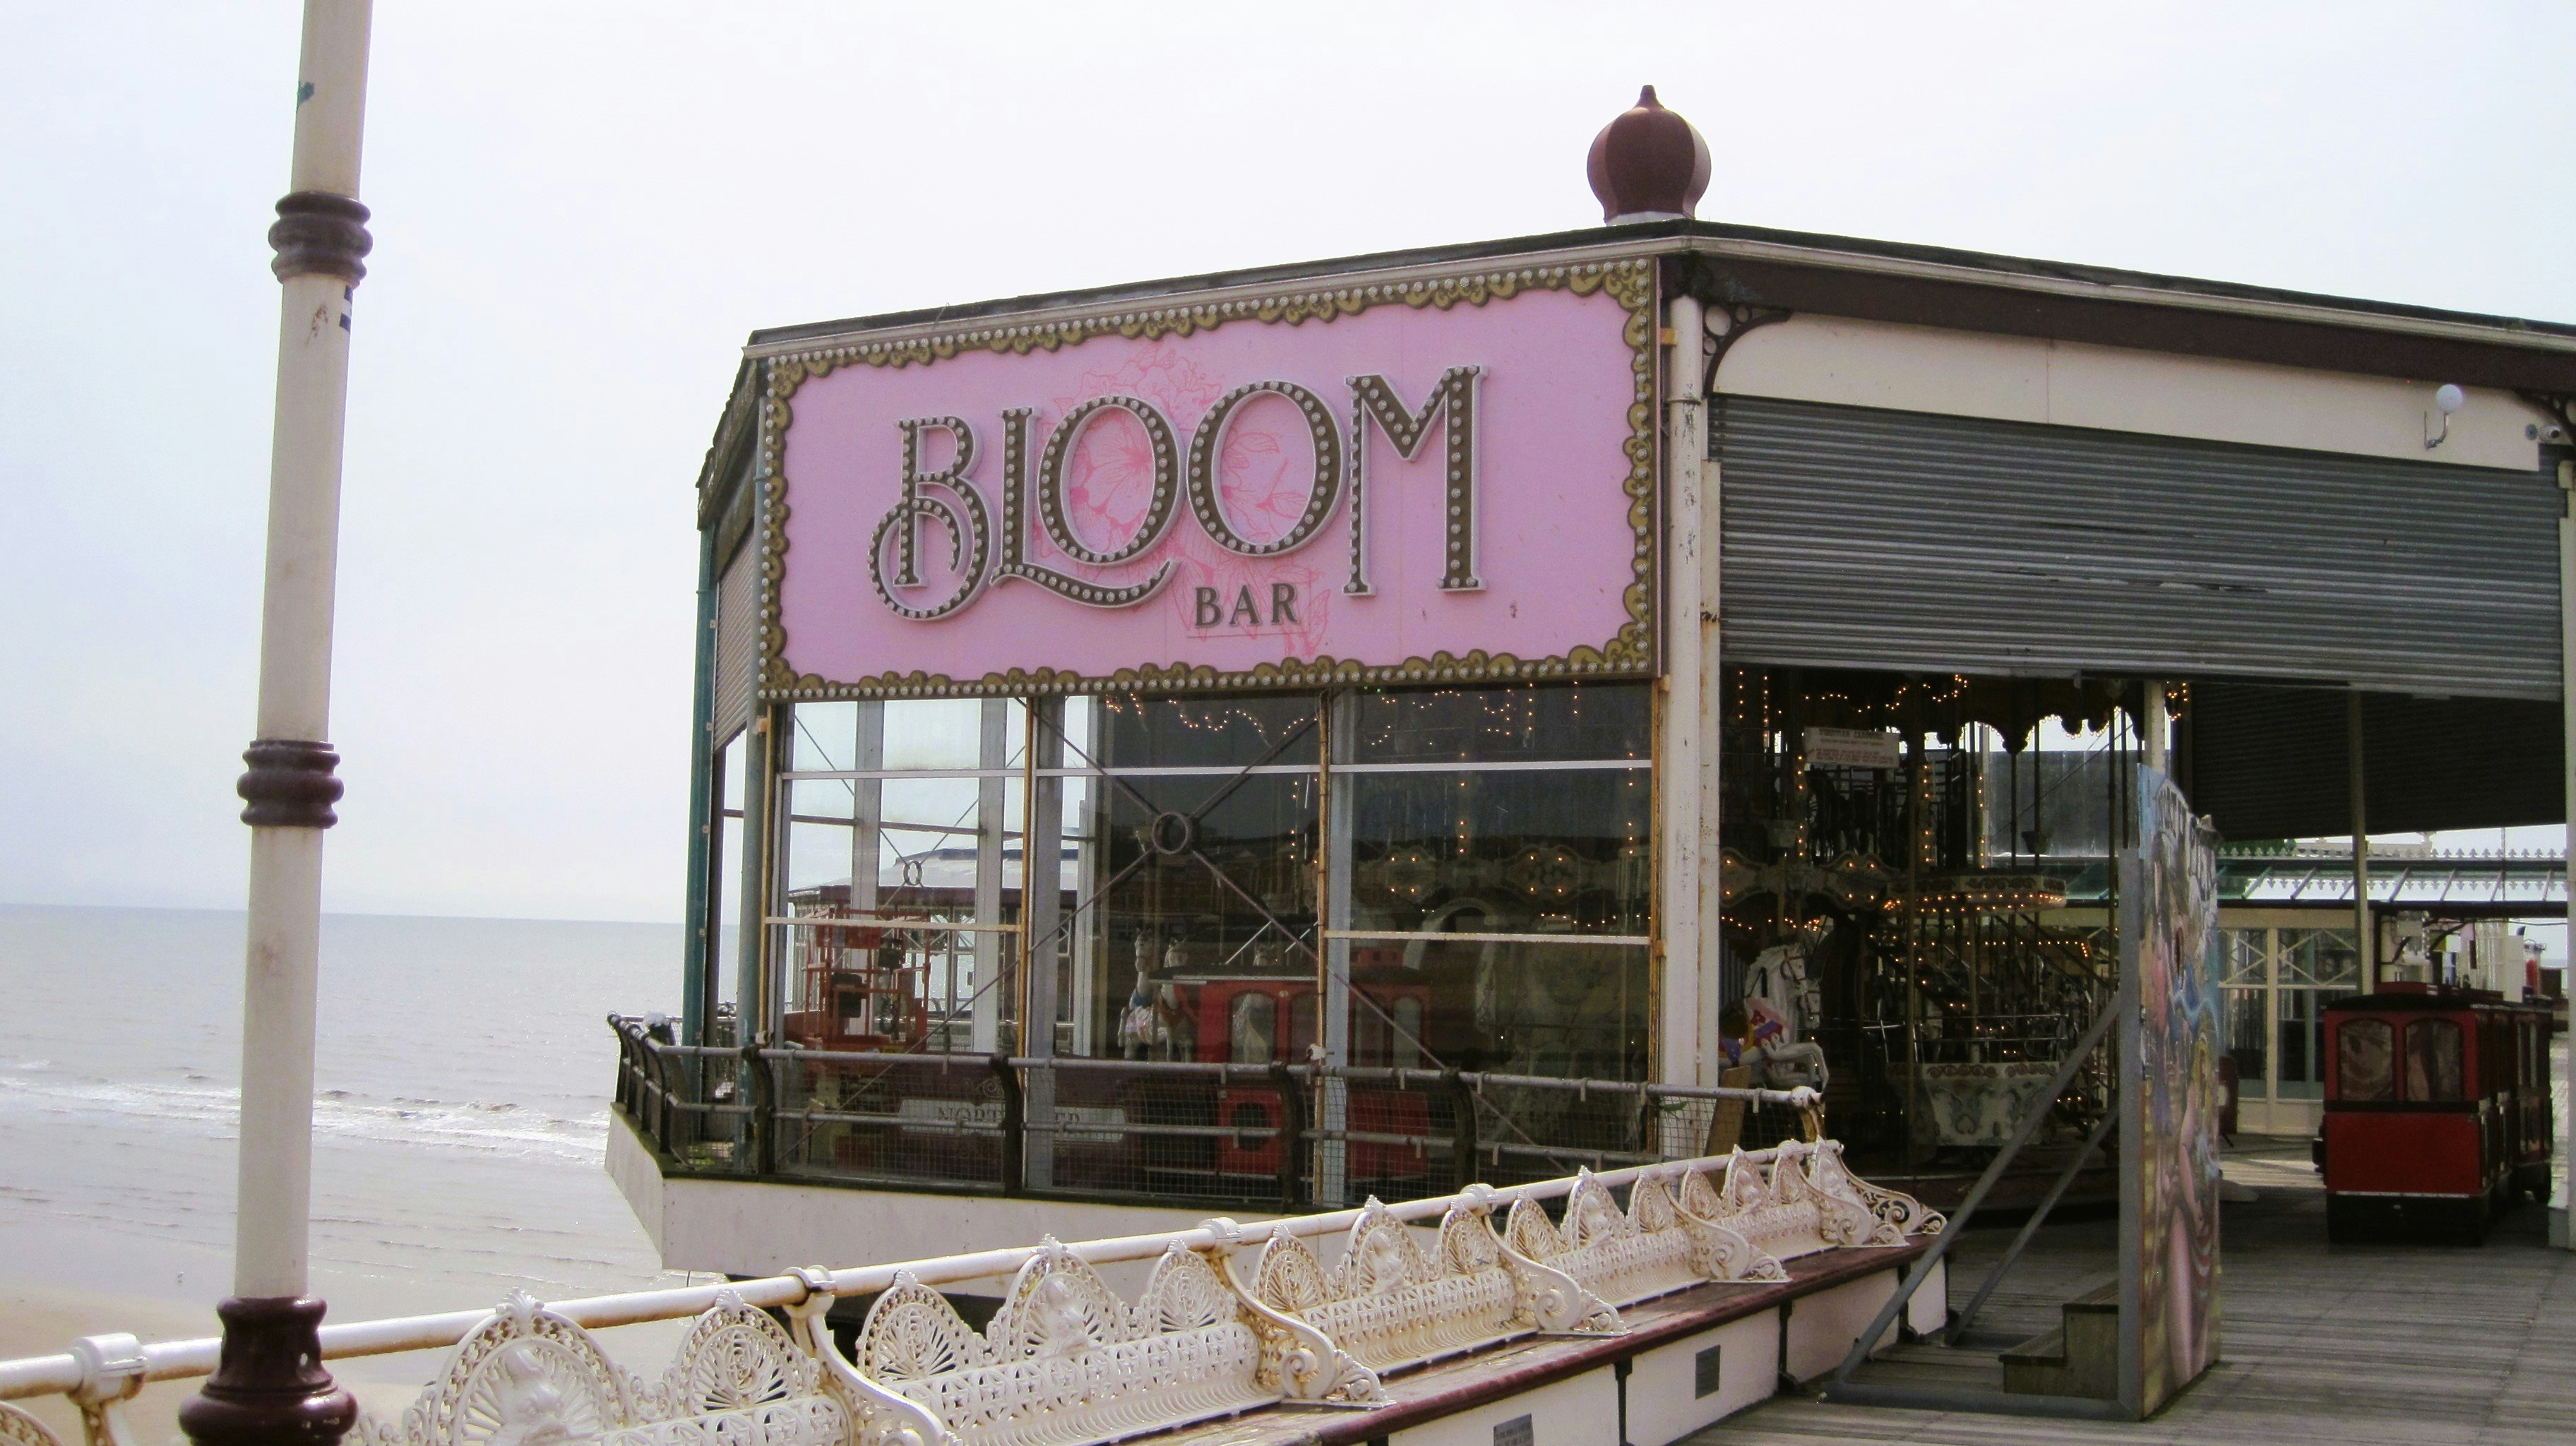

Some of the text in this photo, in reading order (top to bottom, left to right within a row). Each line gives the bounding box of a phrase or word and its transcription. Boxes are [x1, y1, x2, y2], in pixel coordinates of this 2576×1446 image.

[868, 364, 1488, 621] BLOOM
[1195, 582, 1299, 628] BAR
[937, 1106, 1003, 1123] NORT
